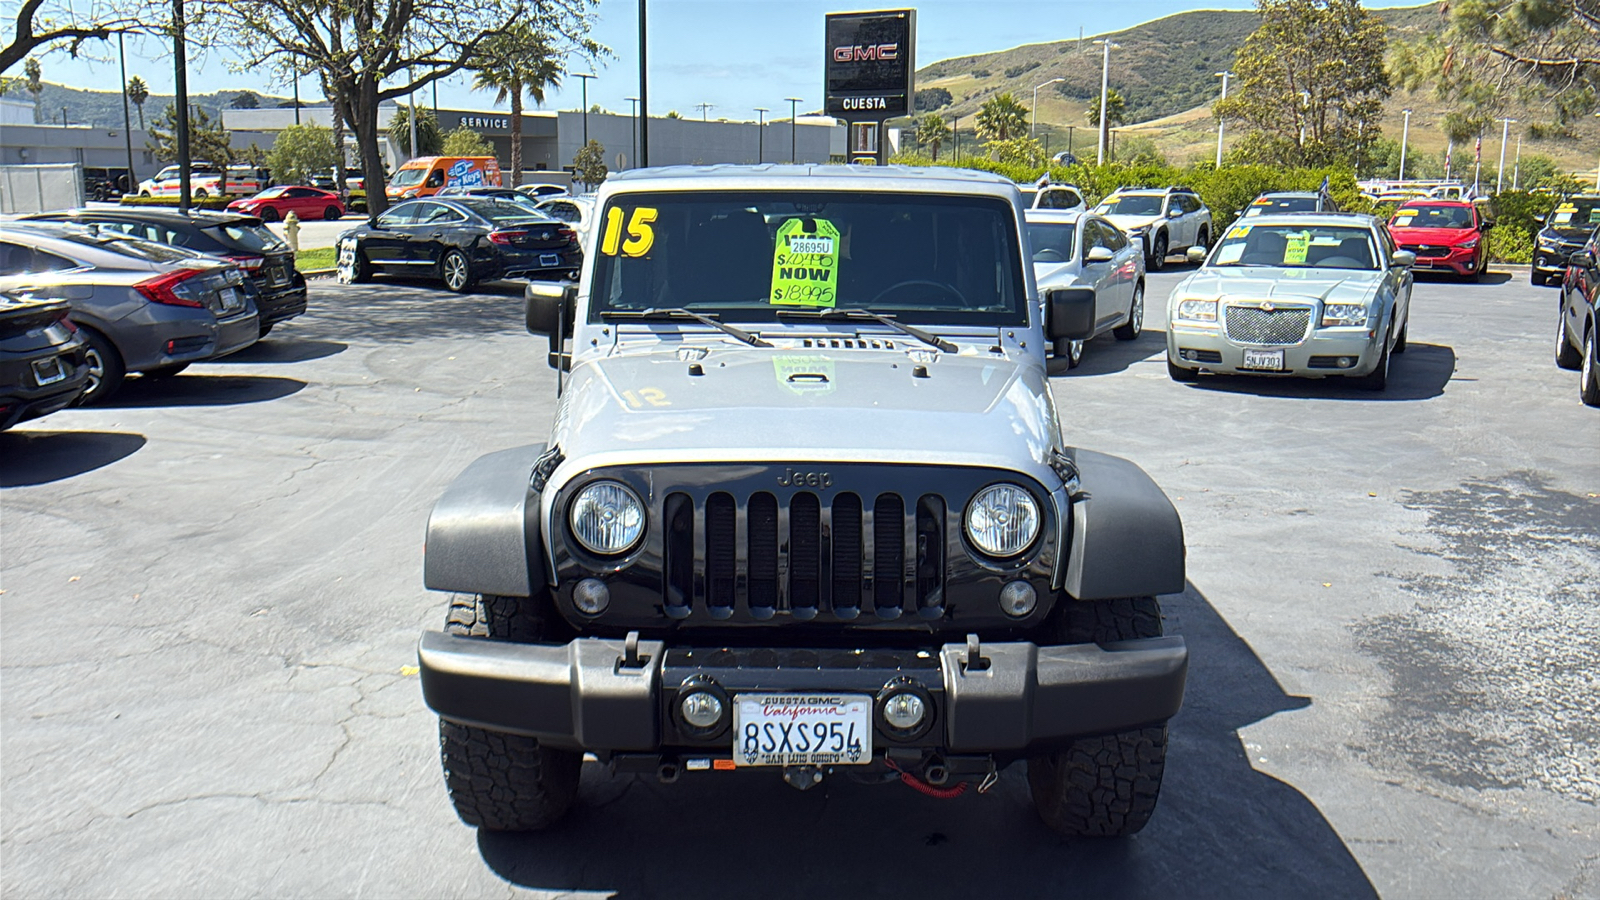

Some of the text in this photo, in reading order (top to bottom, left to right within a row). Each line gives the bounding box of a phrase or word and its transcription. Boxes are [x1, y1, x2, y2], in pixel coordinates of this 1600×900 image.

[834, 43, 897, 61] GMC
[843, 97, 886, 110] CUESTA
[461, 117, 508, 128] SERVICE
[462, 170, 481, 184] Keys
[601, 206, 658, 257] 15
[793, 242, 830, 253] 28695U
[780, 267, 831, 281] NOW
[1246, 356, 1281, 368] 5NJV303
[777, 468, 832, 491] Jeep
[765, 697, 841, 705] CUESTA GMC
[763, 704, 846, 720] California
[745, 722, 861, 753] 8SXS954
[765, 753, 840, 764] SAN LUIS OBISPO
